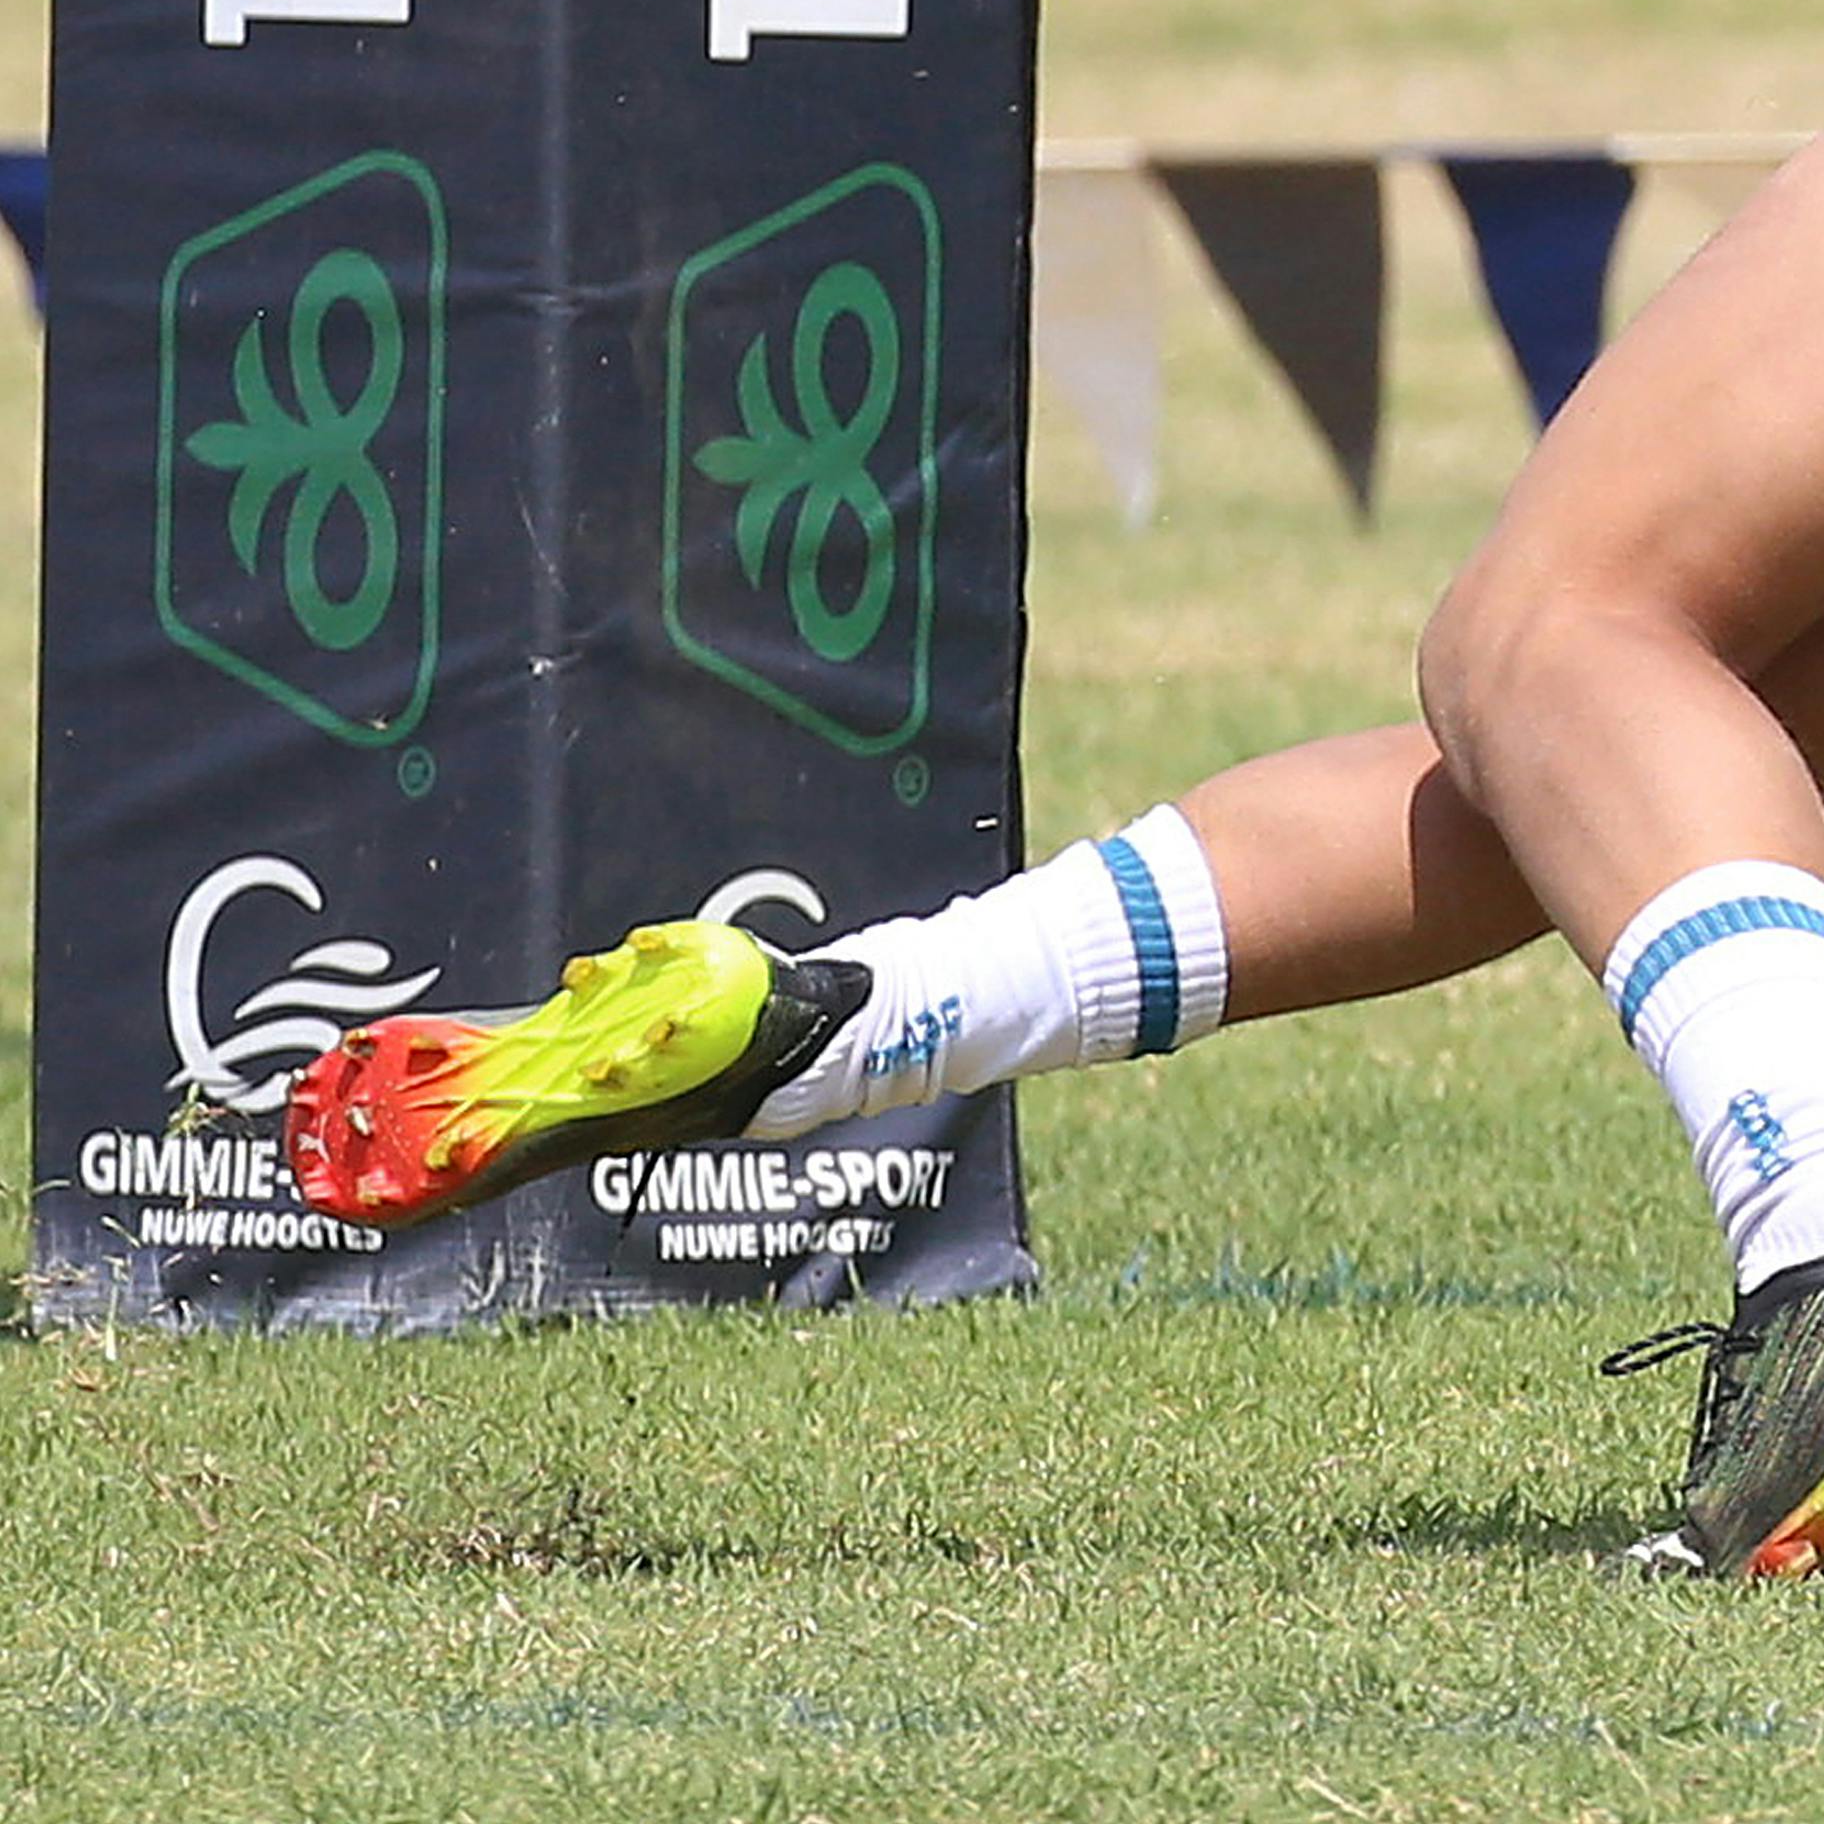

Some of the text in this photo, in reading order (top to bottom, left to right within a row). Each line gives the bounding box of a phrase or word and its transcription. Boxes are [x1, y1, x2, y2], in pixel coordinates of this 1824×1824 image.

[80, 1131, 302, 1202] GIMMIE-
[593, 1148, 954, 1213] GIMMIE-SPORT
[141, 1207, 228, 1246] NUWE
[660, 1222, 759, 1261] NUWE
